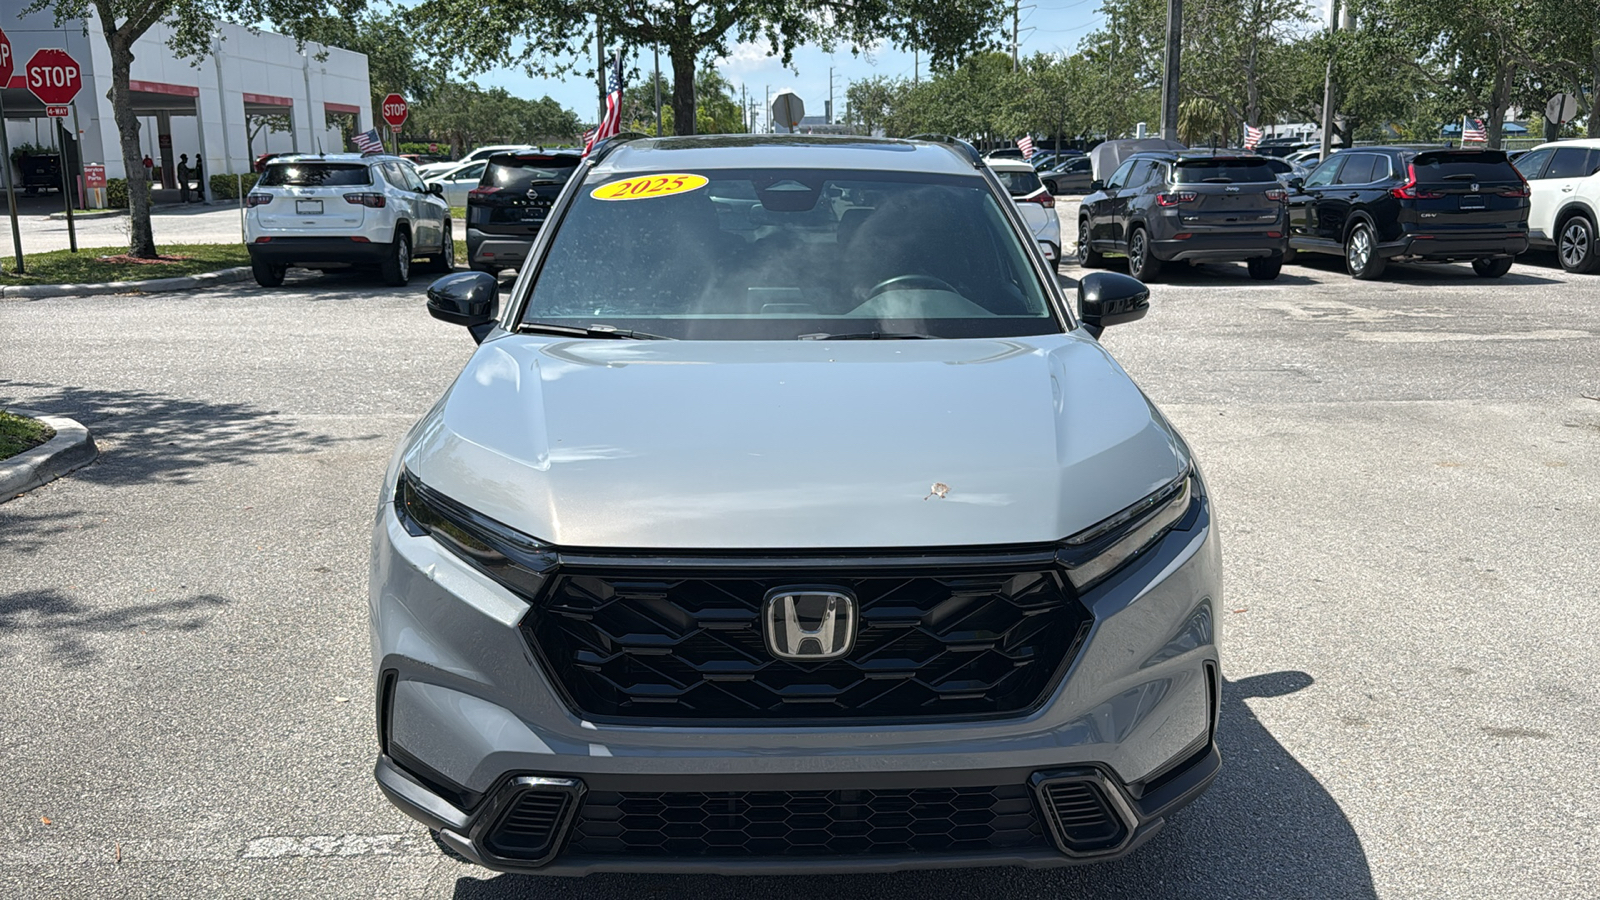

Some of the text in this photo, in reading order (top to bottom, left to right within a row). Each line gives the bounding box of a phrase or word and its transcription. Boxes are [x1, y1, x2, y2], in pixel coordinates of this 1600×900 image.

[0, 43, 9, 67] P
[30, 66, 77, 87] STOP
[384, 103, 406, 117] STOP
[609, 176, 689, 198] 2025
